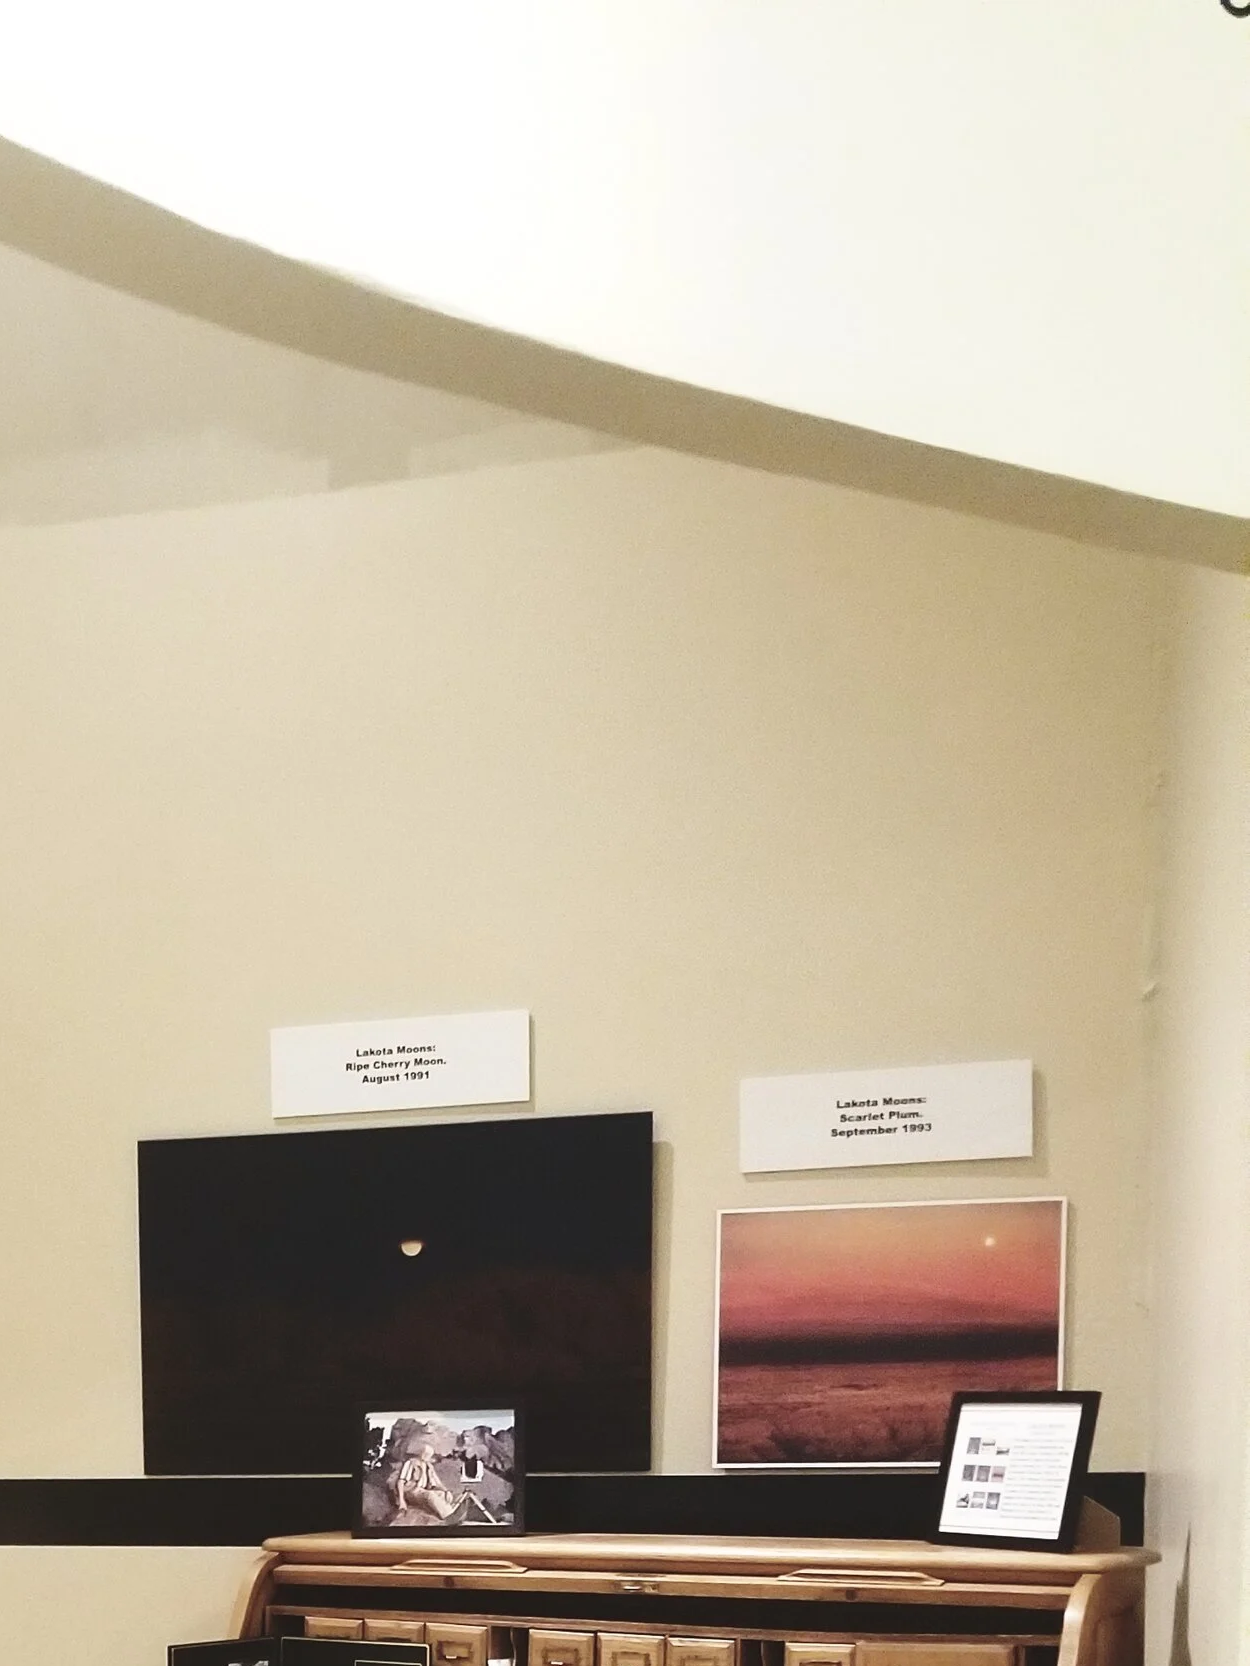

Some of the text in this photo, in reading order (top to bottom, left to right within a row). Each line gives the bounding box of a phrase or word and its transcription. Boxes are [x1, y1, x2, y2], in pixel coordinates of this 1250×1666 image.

[356, 1044, 437, 1058] Lakota Moons:
[345, 1056, 447, 1072] Ripe Cherry Moon.
[362, 1071, 430, 1085] August 1991
[836, 1097, 927, 1109] Lakota Moons:
[840, 1110, 924, 1123] Scarlet Plum.
[831, 1123, 932, 1138] September 1993
